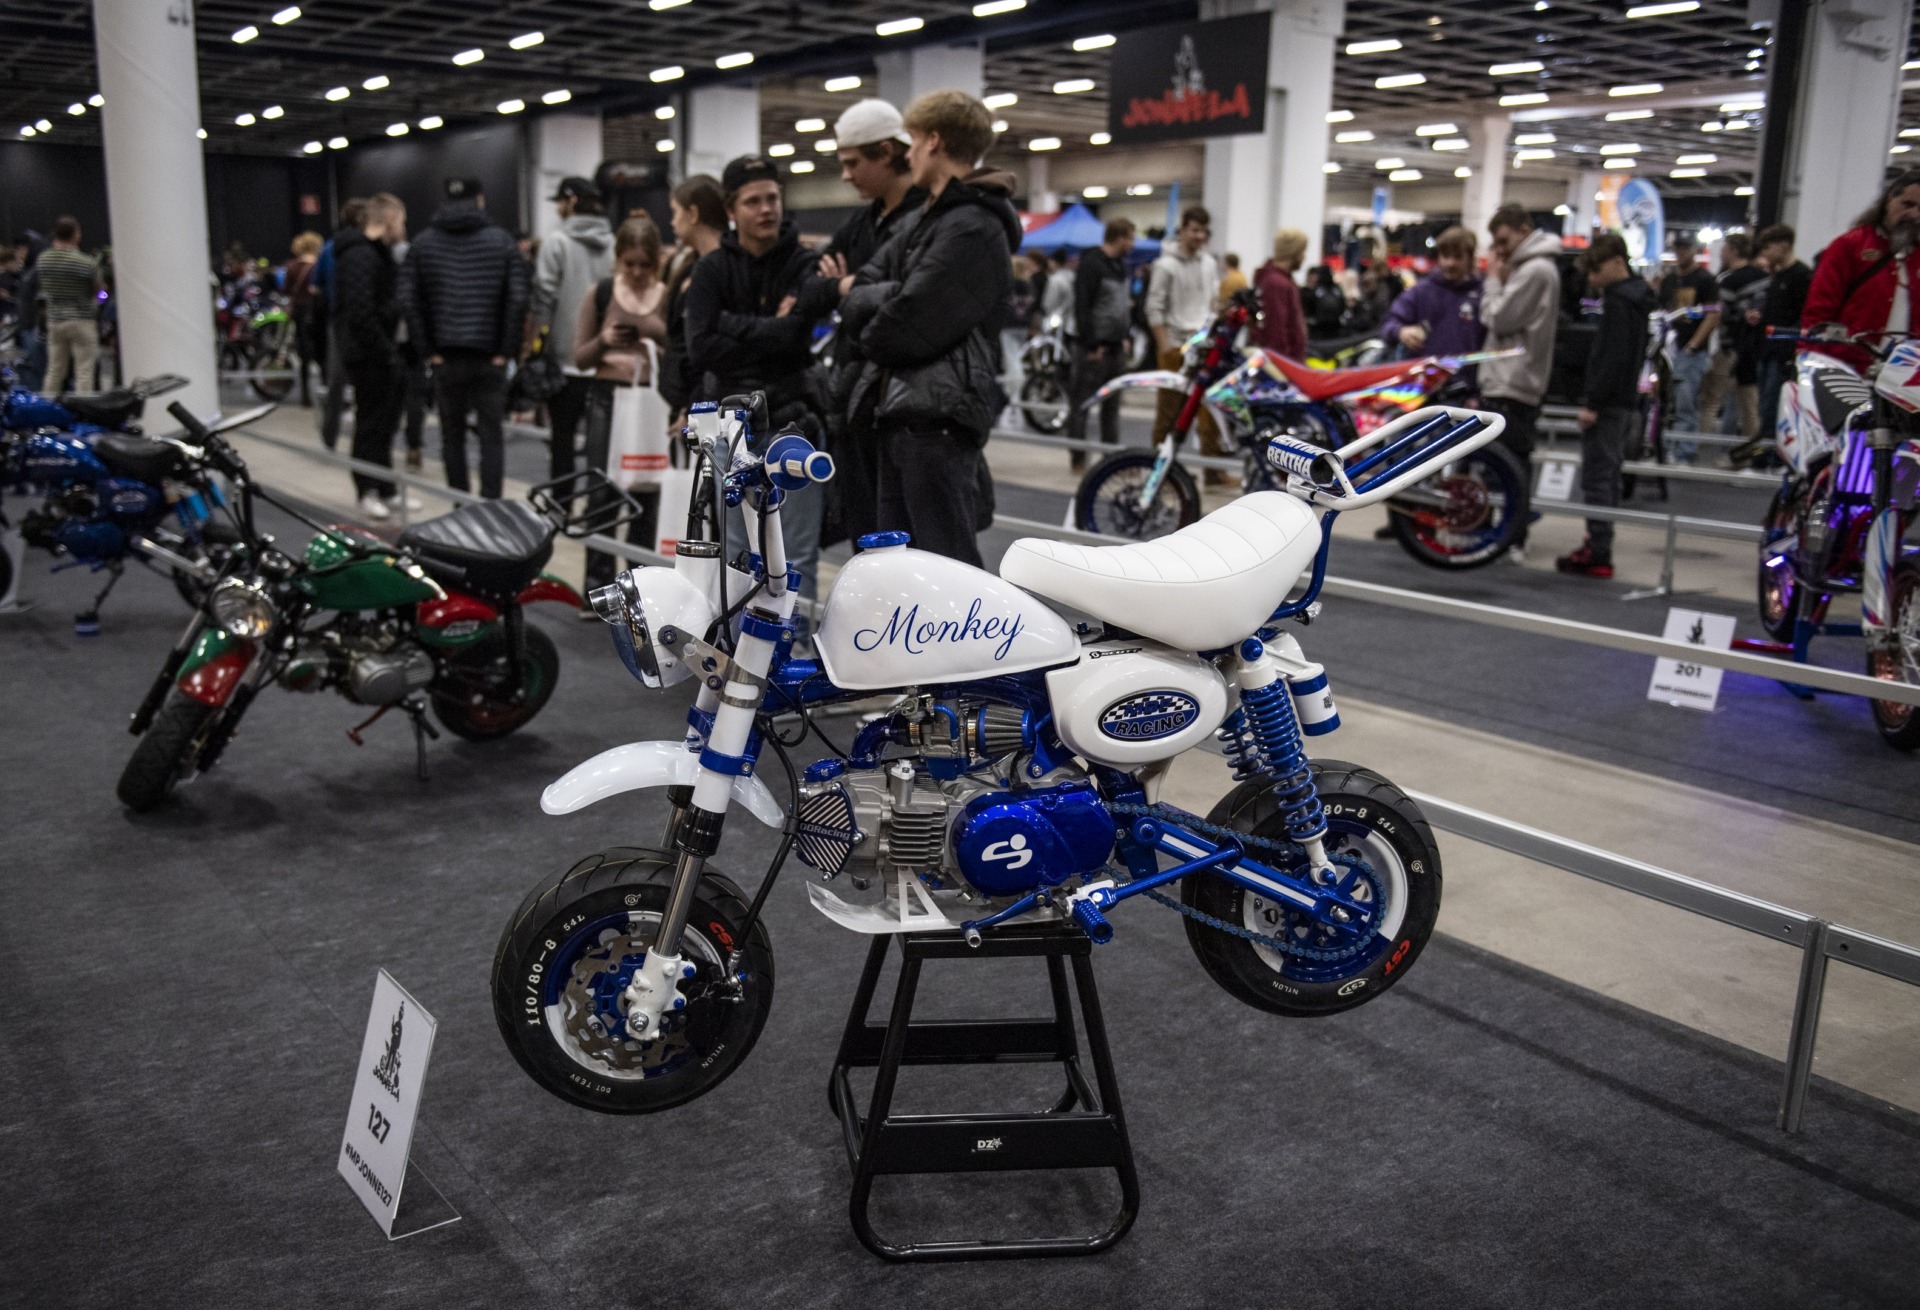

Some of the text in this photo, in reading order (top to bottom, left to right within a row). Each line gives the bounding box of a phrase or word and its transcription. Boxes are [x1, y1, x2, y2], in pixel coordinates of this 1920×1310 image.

[1267, 445, 1313, 477] RENTHA
[853, 597, 1025, 661] Monkey
[1675, 662, 1703, 679] 201
[1114, 711, 1187, 736] RACING
[1322, 803, 1396, 834] 80-8 54L
[525, 913, 586, 1027] 110/80-8 54L
[1384, 938, 1411, 976] CST
[1272, 980, 1299, 995] NYLON
[701, 1043, 726, 1069] NYLON
[595, 1084, 612, 1094] DOT
[367, 1103, 391, 1144] 127
[344, 1141, 393, 1208] #MPJONNE127
